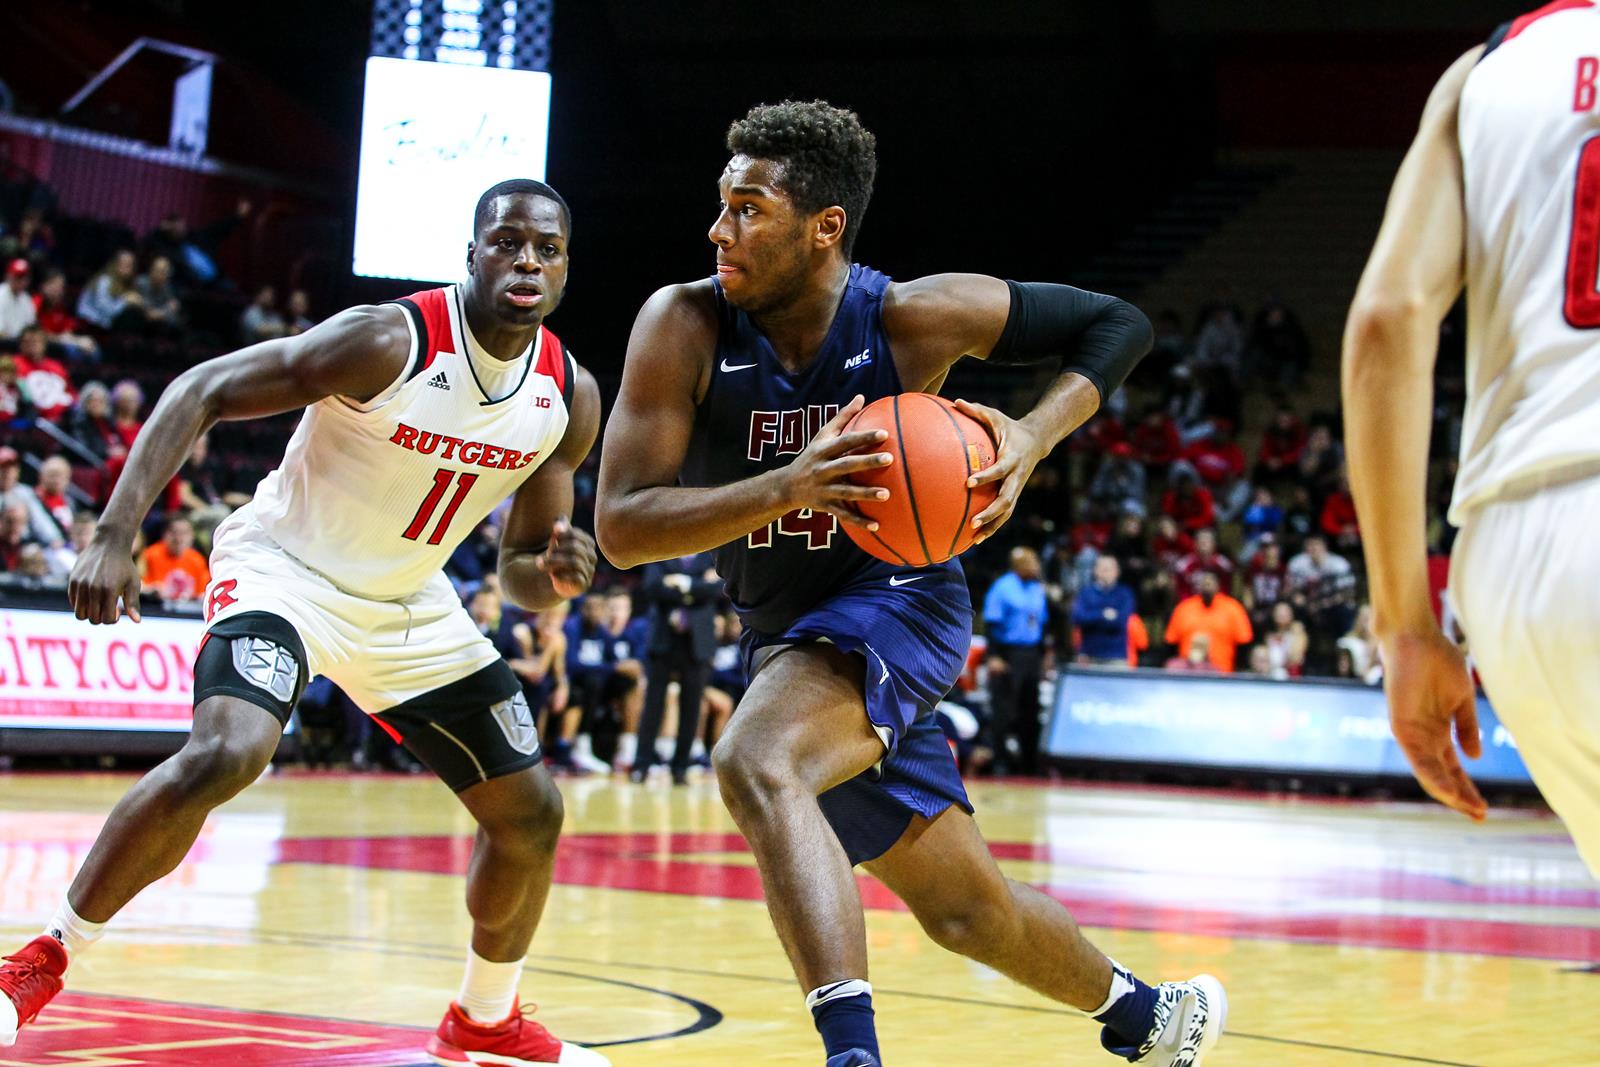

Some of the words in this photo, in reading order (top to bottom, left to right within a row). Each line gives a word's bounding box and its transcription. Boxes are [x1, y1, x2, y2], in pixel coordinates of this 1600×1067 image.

[1572, 56, 1599, 113] B
[844, 349, 870, 370] NEC
[427, 381, 450, 391] adidas
[389, 422, 540, 470] RUTGERS
[401, 468, 480, 545] 11
